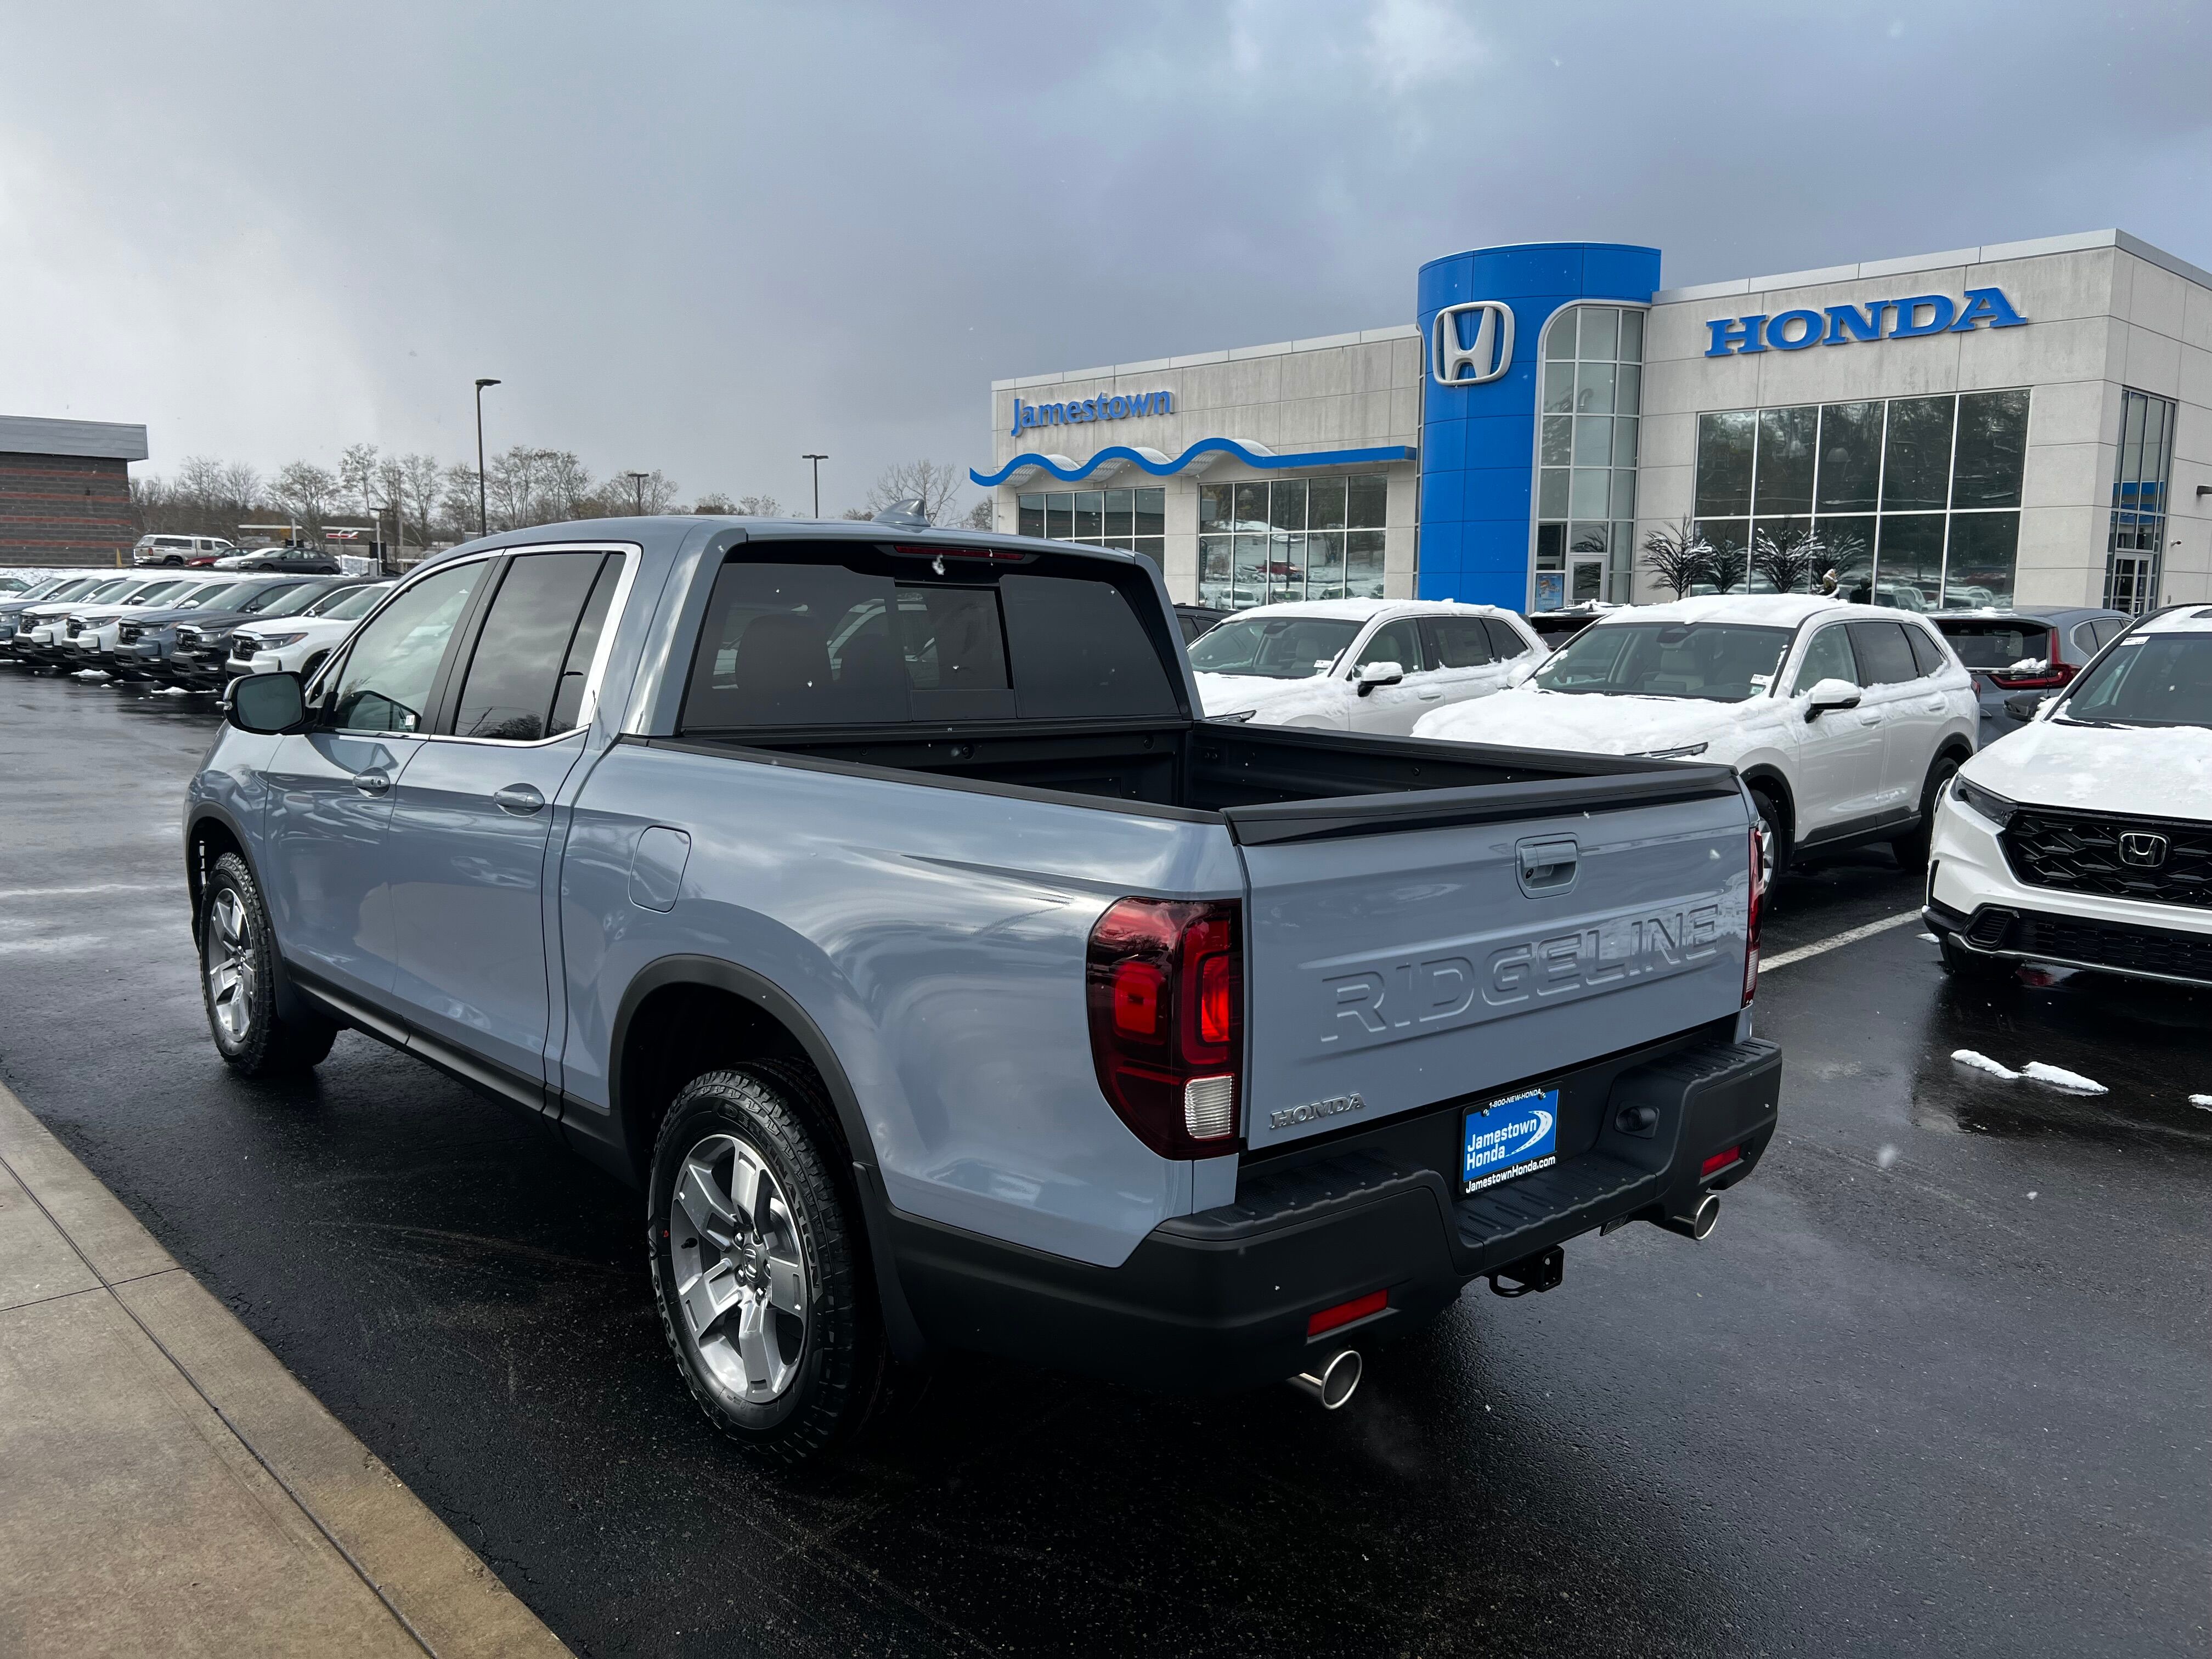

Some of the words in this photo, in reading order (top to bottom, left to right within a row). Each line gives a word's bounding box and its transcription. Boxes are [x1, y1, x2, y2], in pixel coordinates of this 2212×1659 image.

[1705, 287, 2027, 357] HONDA
[1011, 392, 1173, 437] Jamestown
[1320, 904, 1719, 1042] RIDGELINE
[1269, 1093, 1366, 1130] HONDA
[1489, 1088, 1541, 1109] 1-800-NEW-HONDA
[1468, 1118, 1537, 1152] Jamestown
[1465, 1155, 1556, 1194] JamestownHonda.com
[1466, 1143, 1505, 1171] Honda
[723, 1103, 820, 1288] DESTINATION
